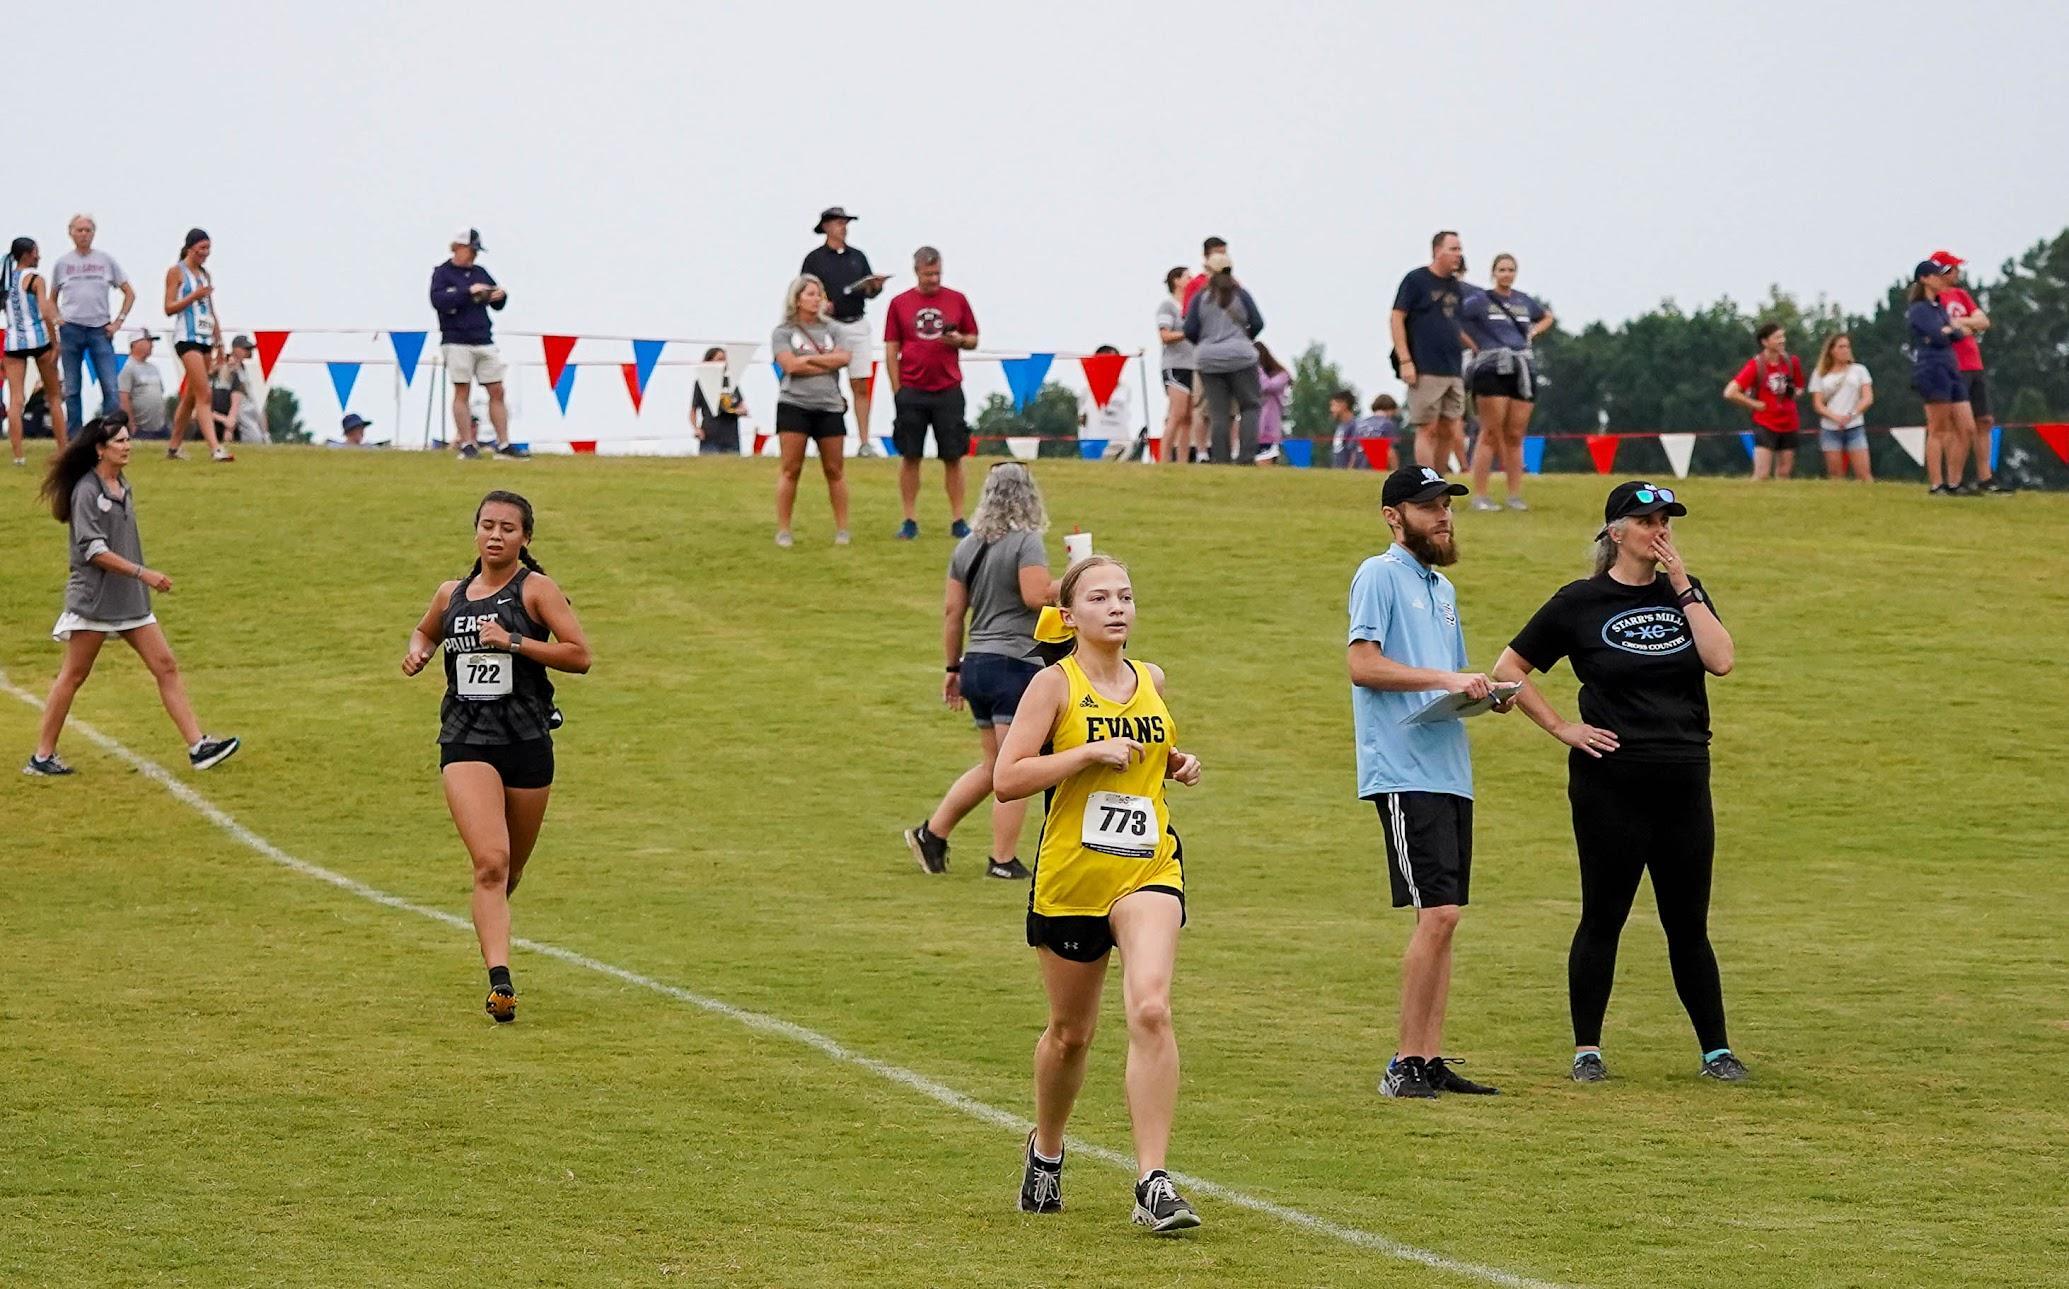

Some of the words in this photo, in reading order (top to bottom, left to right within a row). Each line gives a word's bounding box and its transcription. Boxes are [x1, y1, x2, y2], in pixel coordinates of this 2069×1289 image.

[1611, 613, 1654, 633] STARR'S
[1655, 612, 1684, 626] MILL
[1621, 640, 1648, 651] CROSS
[1648, 635, 1686, 651] COUNTRY
[466, 664, 501, 684] 722
[1086, 715, 1165, 743] EVANS
[1100, 805, 1147, 837] 773
